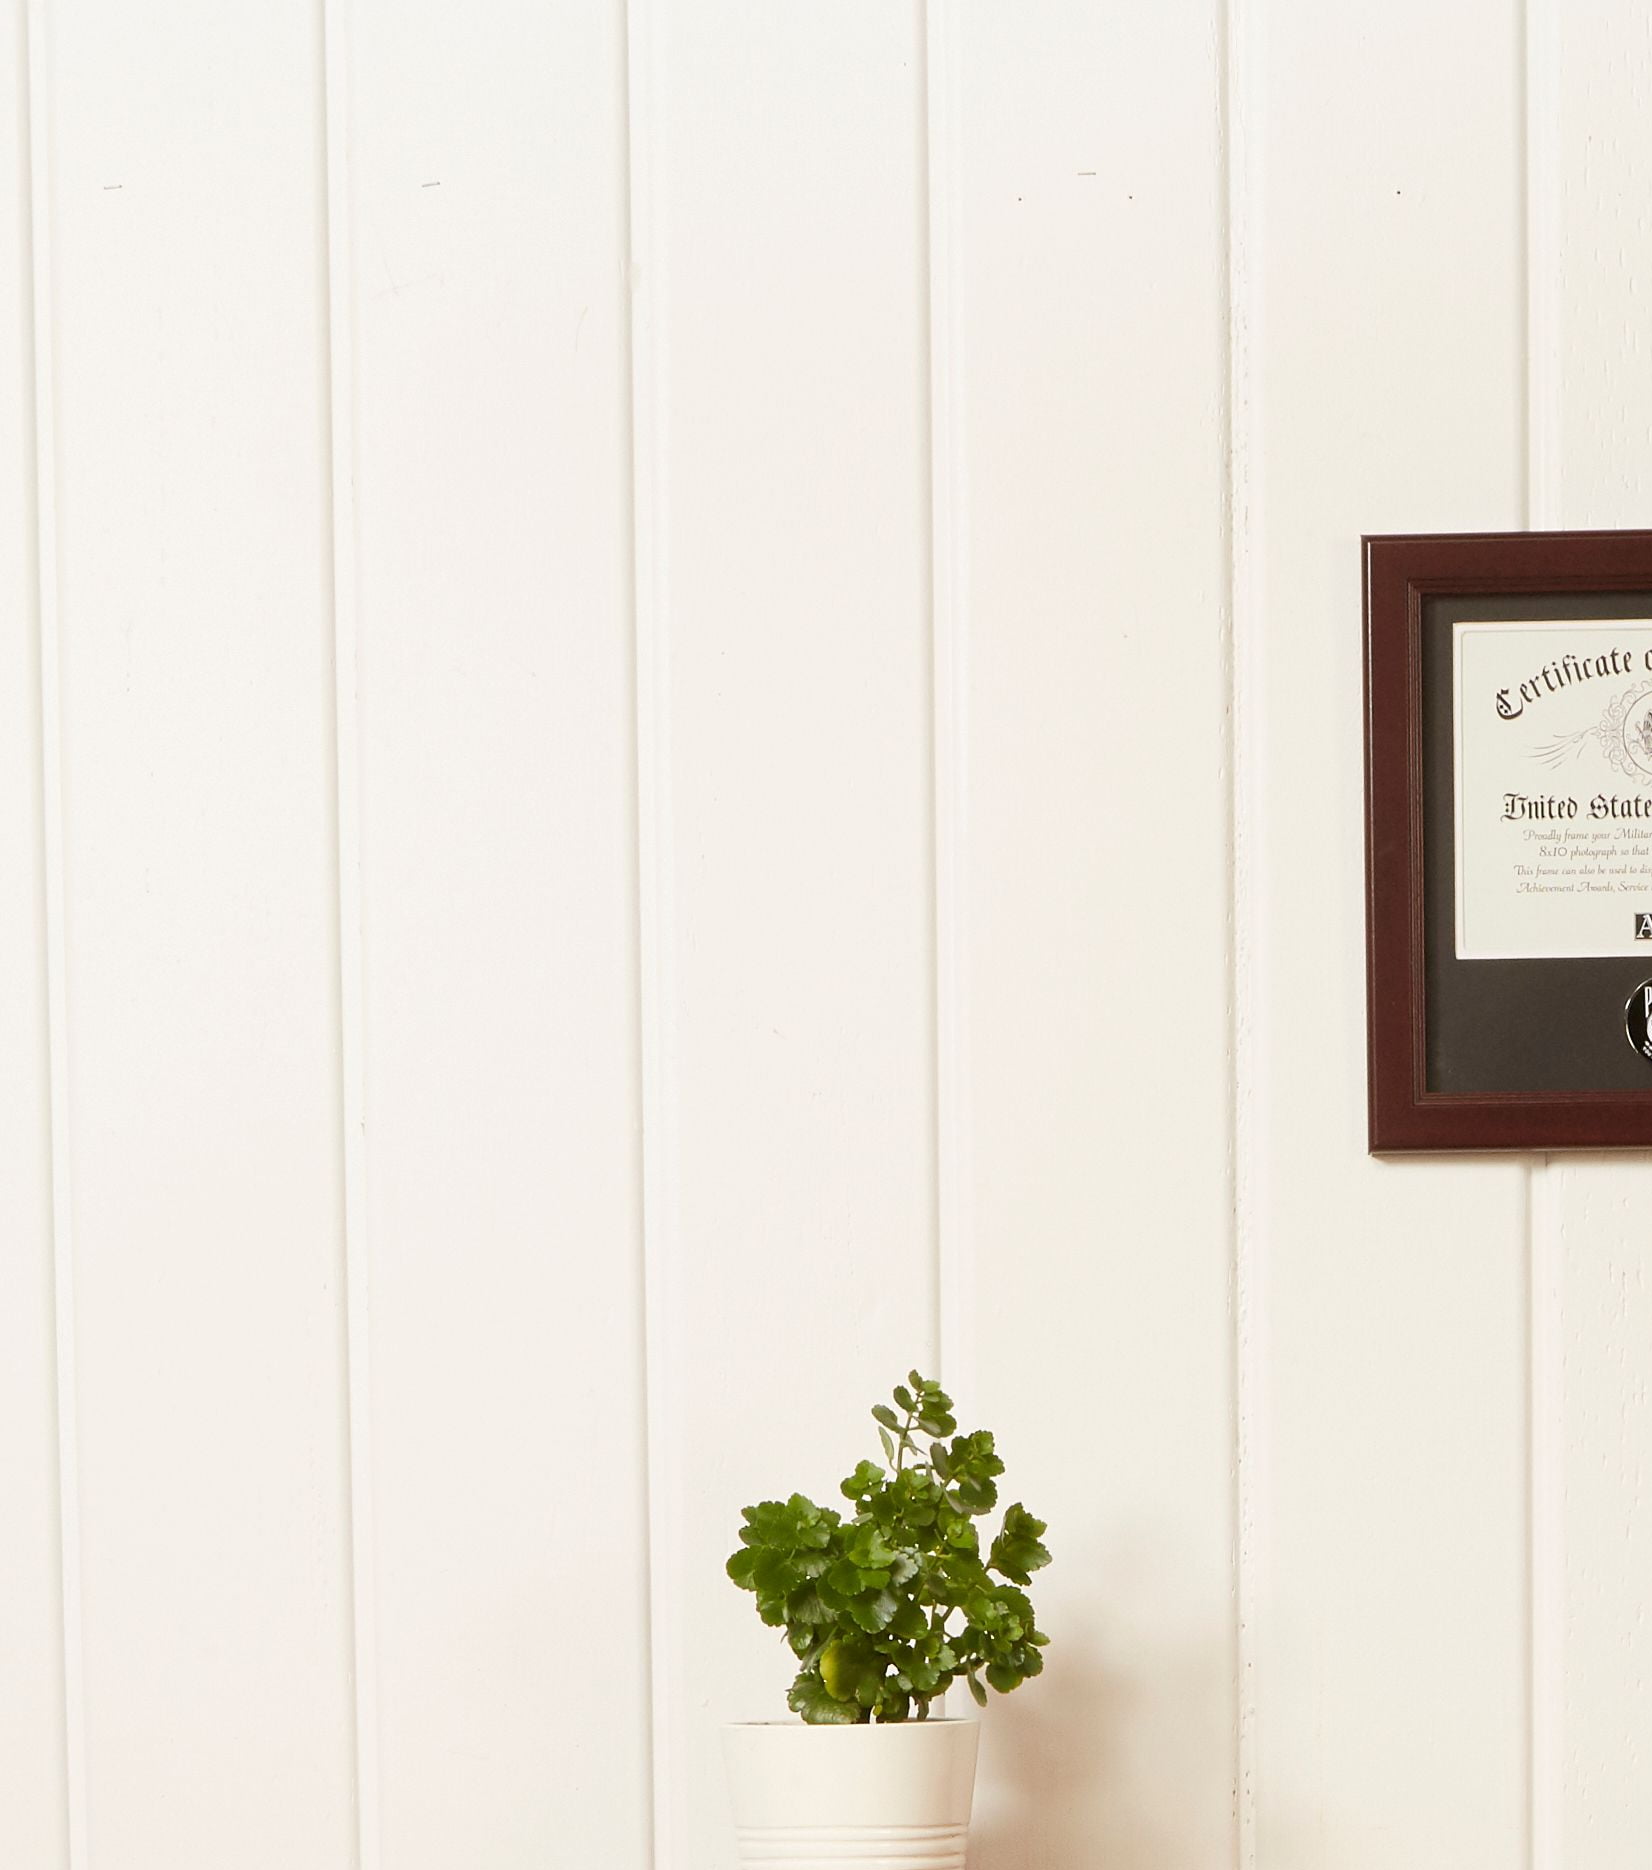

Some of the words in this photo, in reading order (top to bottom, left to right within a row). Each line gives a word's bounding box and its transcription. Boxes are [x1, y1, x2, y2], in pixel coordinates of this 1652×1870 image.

[1496, 648, 1632, 720] Certificate
[1500, 793, 1578, 821] United
[1522, 829, 1562, 843] Proudly
[1563, 828, 1589, 843] frame
[1592, 832, 1611, 843] your
[1539, 846, 1568, 857] 8x10
[1570, 845, 1617, 861] photograph
[1632, 845, 1649, 856] that
[1513, 864, 1533, 876] This
[1535, 864, 1559, 878] frame
[1561, 867, 1577, 875] can
[1579, 865, 1595, 875] also
[1597, 864, 1605, 875] be
[1609, 864, 1627, 875] used
[1630, 864, 1637, 874] to
[1516, 882, 1574, 894] Achievement
[1617, 881, 1649, 892] Service
